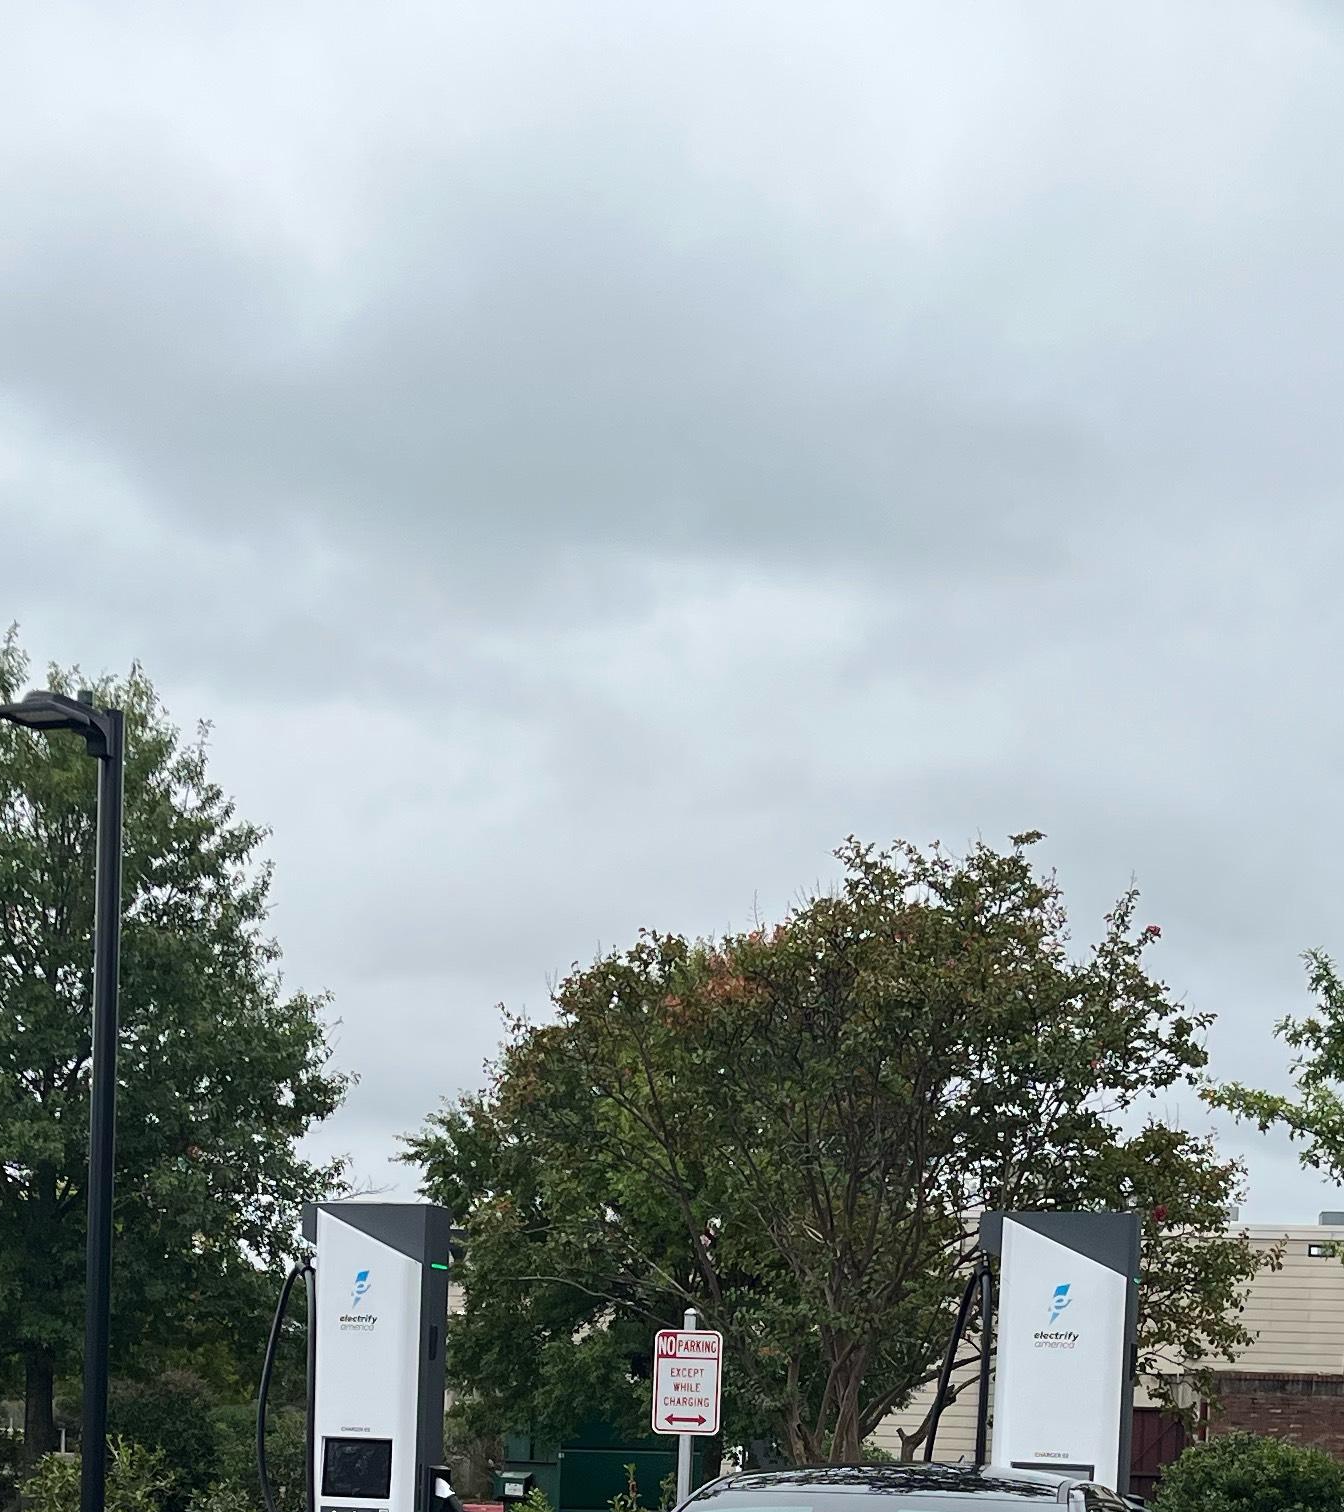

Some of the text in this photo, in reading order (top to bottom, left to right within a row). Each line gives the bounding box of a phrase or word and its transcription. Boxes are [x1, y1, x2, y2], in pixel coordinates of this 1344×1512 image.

[339, 1314, 378, 1324] electrify
[1034, 1331, 1079, 1342] electrify
[658, 1335, 717, 1356] NO PARKING
[670, 1367, 705, 1378] EXCEPT
[673, 1381, 701, 1393] WHILE
[663, 1396, 710, 1408] CHARGING
